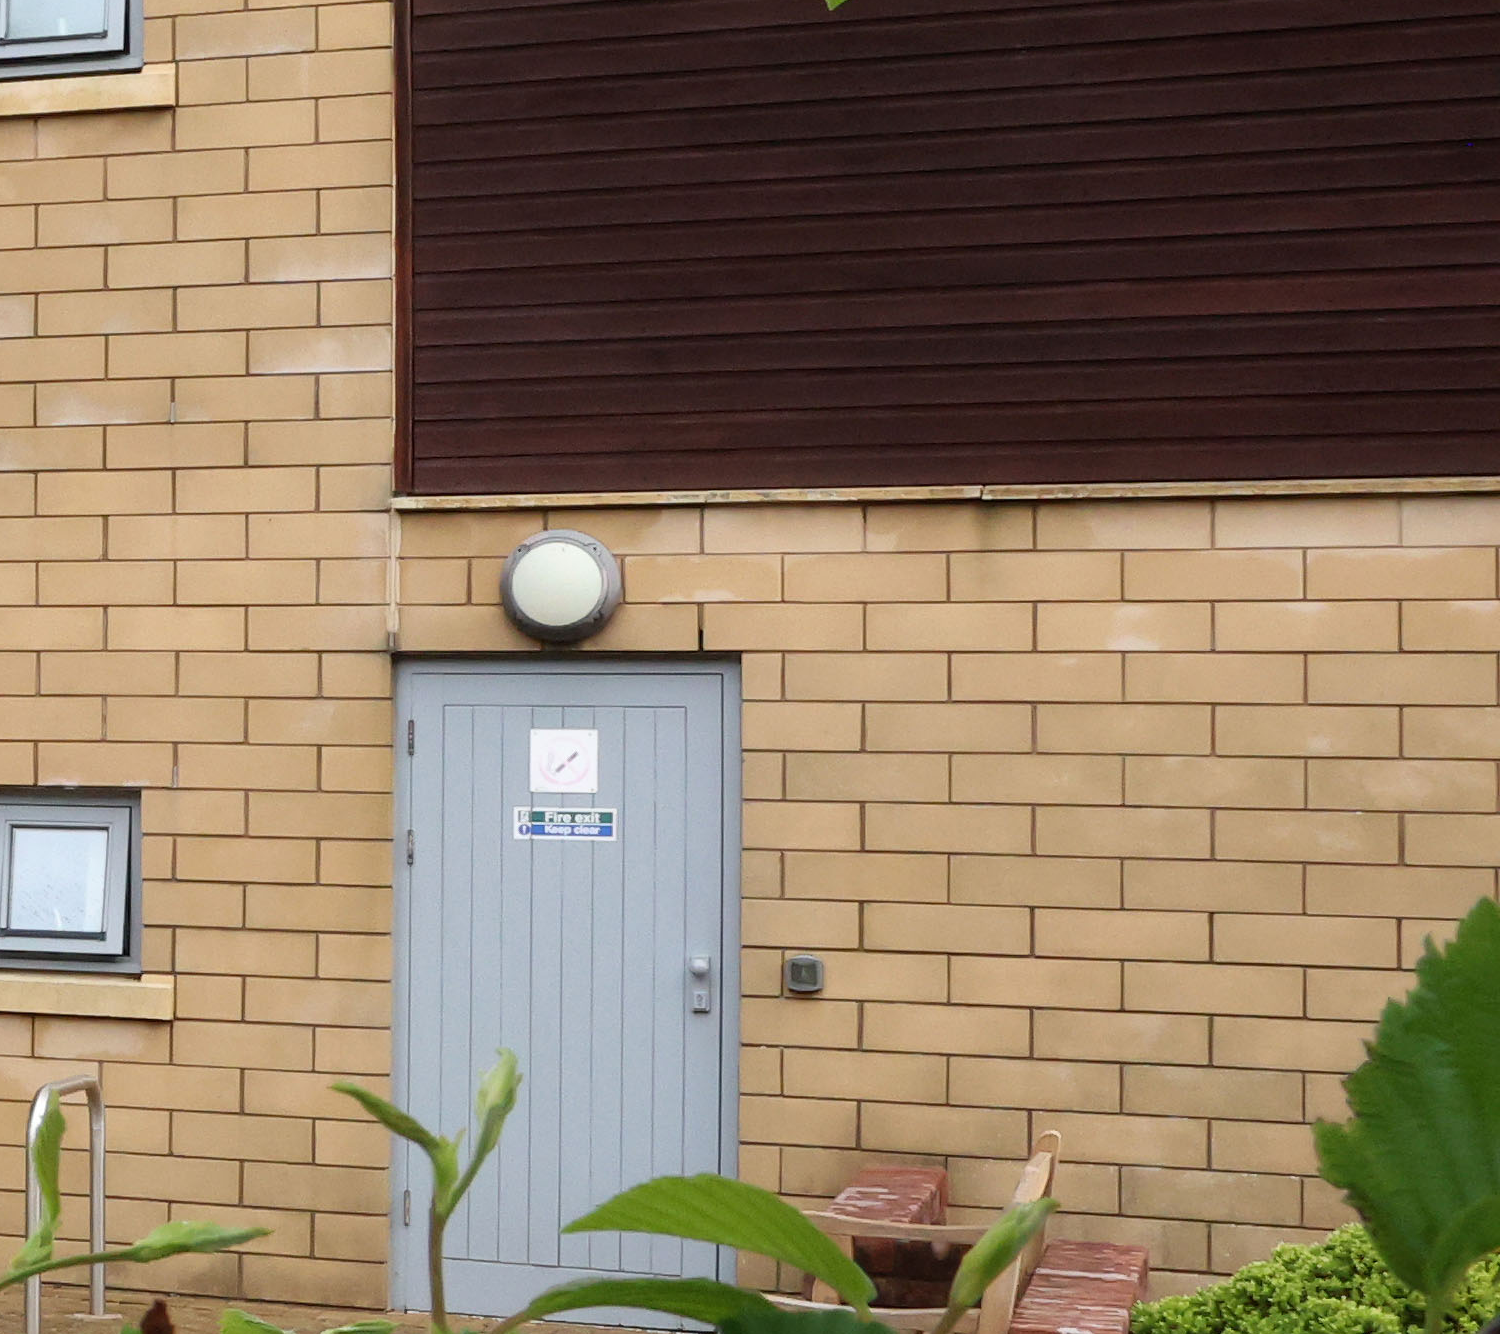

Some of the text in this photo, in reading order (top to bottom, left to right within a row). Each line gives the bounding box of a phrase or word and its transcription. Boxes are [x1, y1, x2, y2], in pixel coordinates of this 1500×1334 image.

[545, 811, 601, 823] Fire exit
[545, 825, 601, 835] Keep clear
